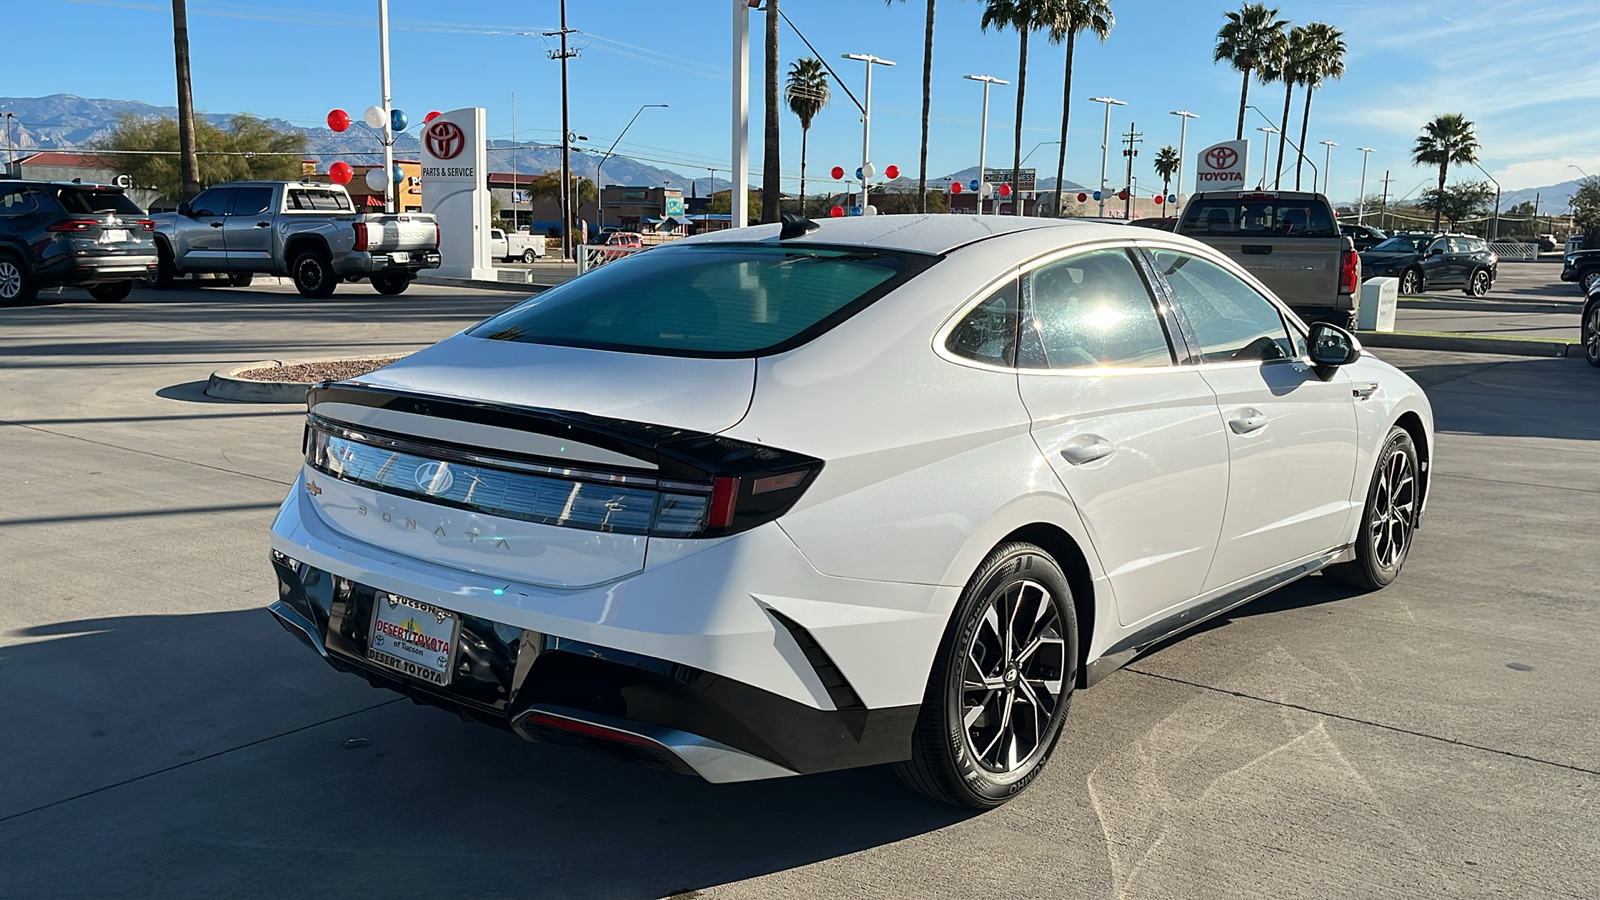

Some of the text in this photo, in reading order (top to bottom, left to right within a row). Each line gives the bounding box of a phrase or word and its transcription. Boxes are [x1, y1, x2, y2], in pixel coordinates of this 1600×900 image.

[422, 167, 474, 177] PARTS & SERVICE
[1006, 174, 1035, 182] FINESS
[1198, 171, 1243, 182] TOYOTA
[385, 231, 425, 240] TUNDRA
[358, 505, 510, 550] SONATA
[396, 596, 435, 614] TUCSON
[376, 620, 449, 655] DESERT TOYOTA
[393, 640, 424, 656] of Tucson
[369, 649, 442, 685] DESERT TOYOTA
[1009, 755, 1047, 794] KUMHO
